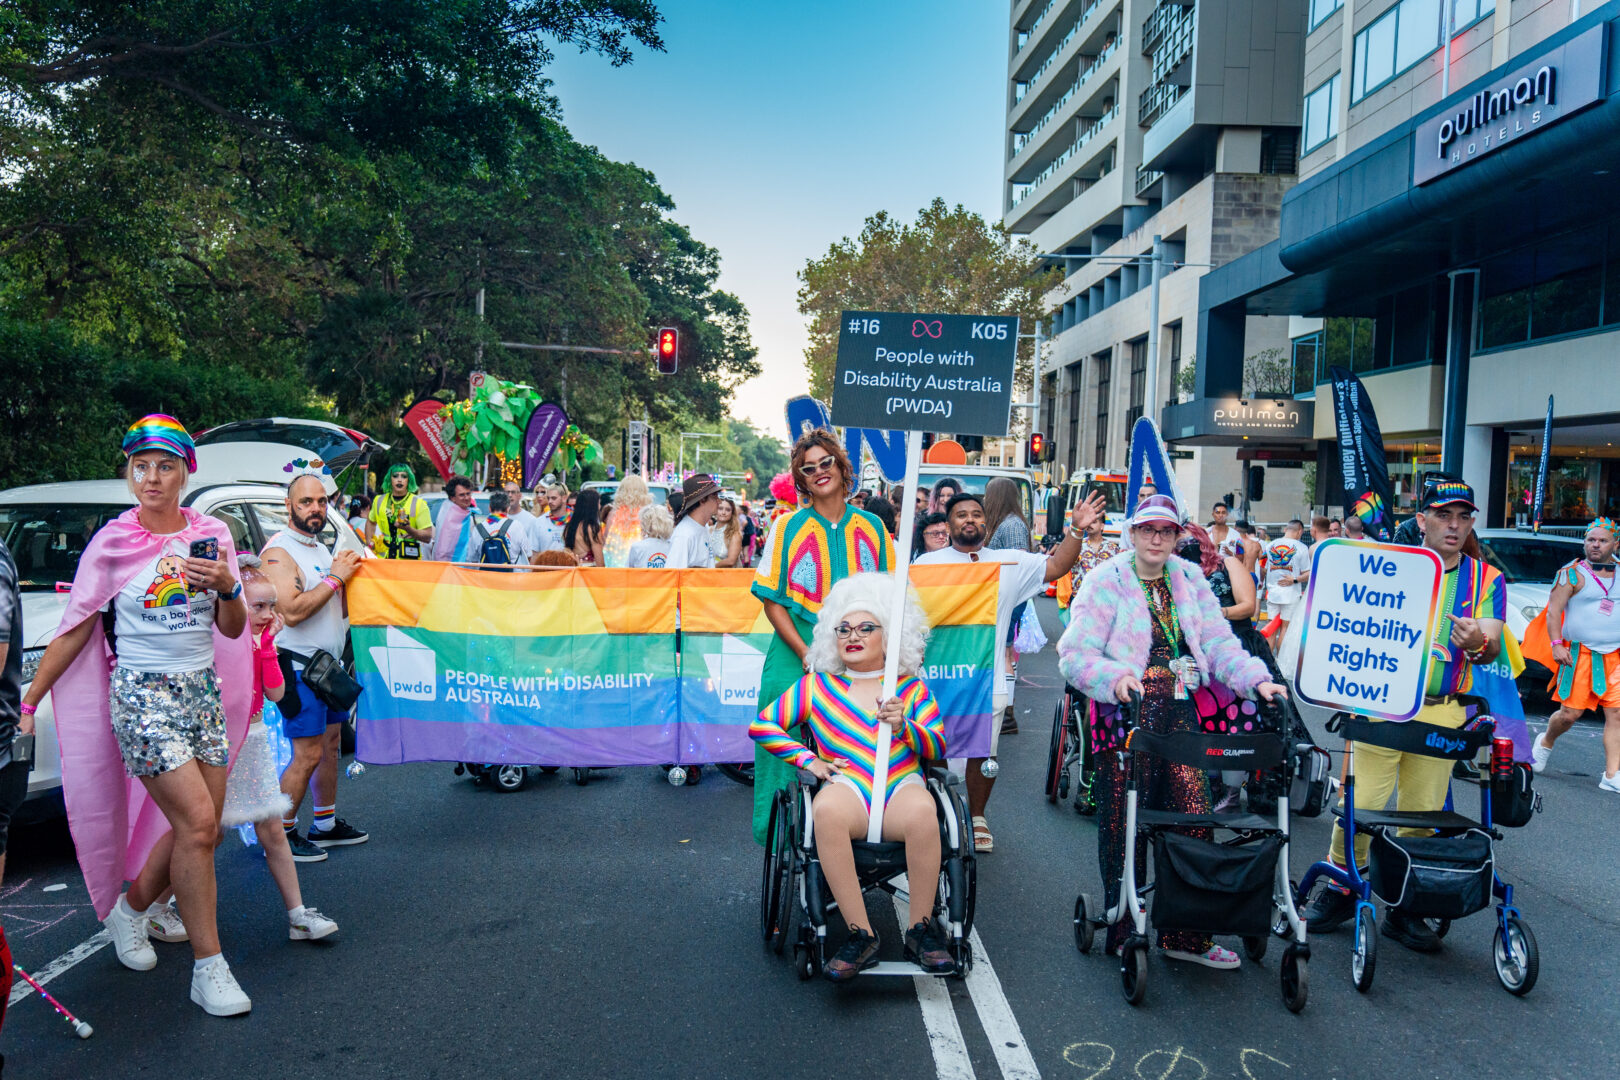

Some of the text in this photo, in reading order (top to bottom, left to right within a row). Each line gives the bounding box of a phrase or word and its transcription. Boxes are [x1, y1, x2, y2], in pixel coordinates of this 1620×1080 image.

[1438, 66, 1553, 159] pullman
[1452, 110, 1541, 162] HOTELS
[848, 318, 1008, 340] #16 K05
[875, 348, 974, 366] People with
[844, 370, 1002, 392] Disability Australia
[886, 397, 953, 418] (PWDA)
[1214, 408, 1299, 424] pullman
[418, 419, 449, 462] EMPOWERING
[1342, 448, 1356, 490] Sydney
[1436, 482, 1470, 498] PRIDE
[1360, 554, 1397, 577] We
[1343, 582, 1406, 610] Want
[142, 614, 157, 622] For
[1316, 610, 1422, 649] Disability
[1328, 643, 1398, 672] Rights
[394, 680, 433, 694] pwda
[445, 669, 654, 691] PEOPLE WITH DISABILITY
[1327, 674, 1389, 703] Now!
[445, 688, 541, 709] AUSTRALIA
